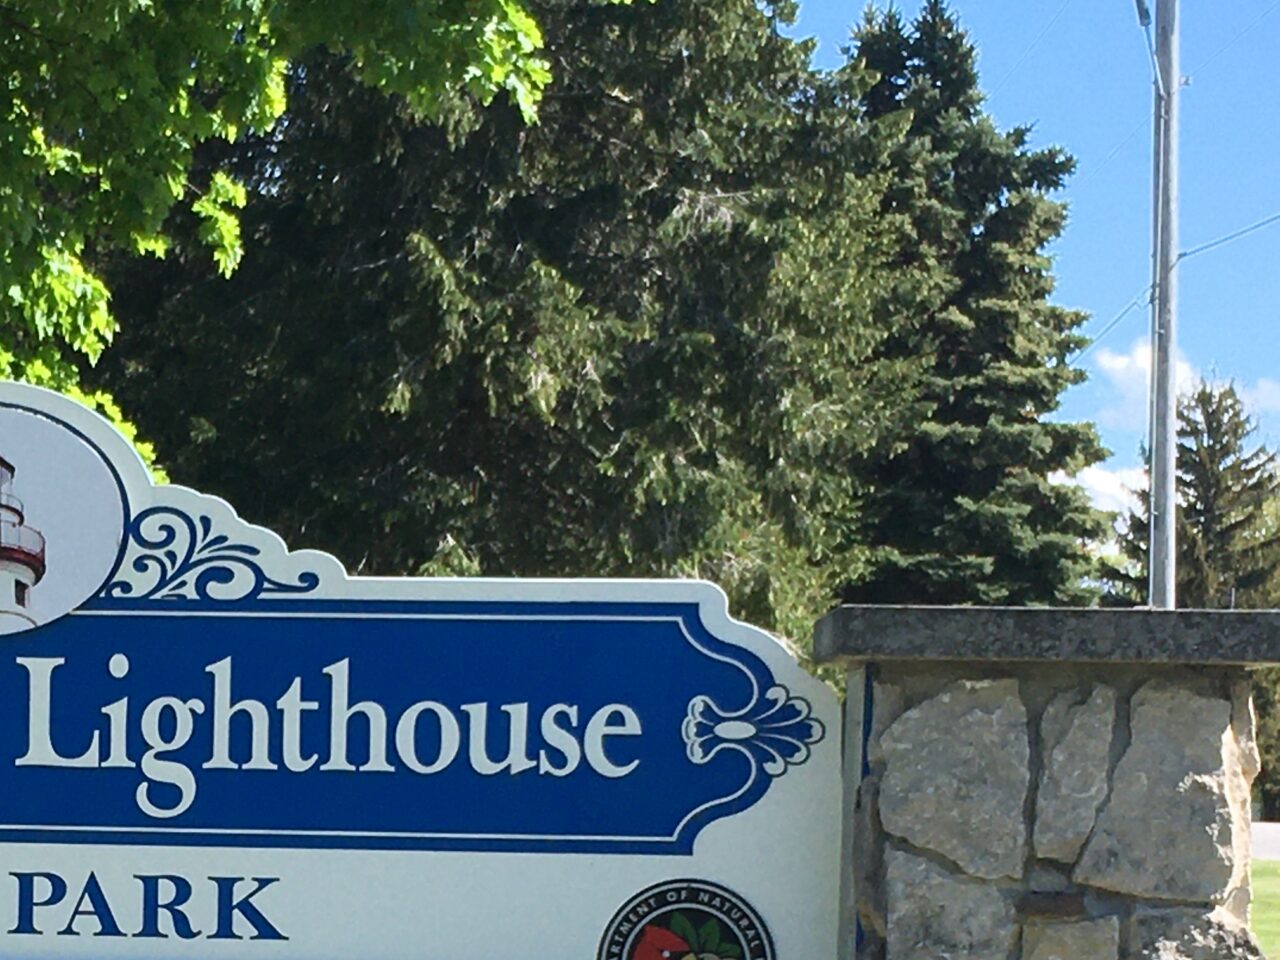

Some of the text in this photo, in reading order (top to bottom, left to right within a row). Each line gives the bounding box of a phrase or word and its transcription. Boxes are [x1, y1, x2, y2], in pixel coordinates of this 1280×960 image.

[15, 653, 642, 819] Lighthouse
[9, 871, 290, 941] PARK
[666, 889, 688, 902] OF
[698, 891, 761, 947] NATURAL
